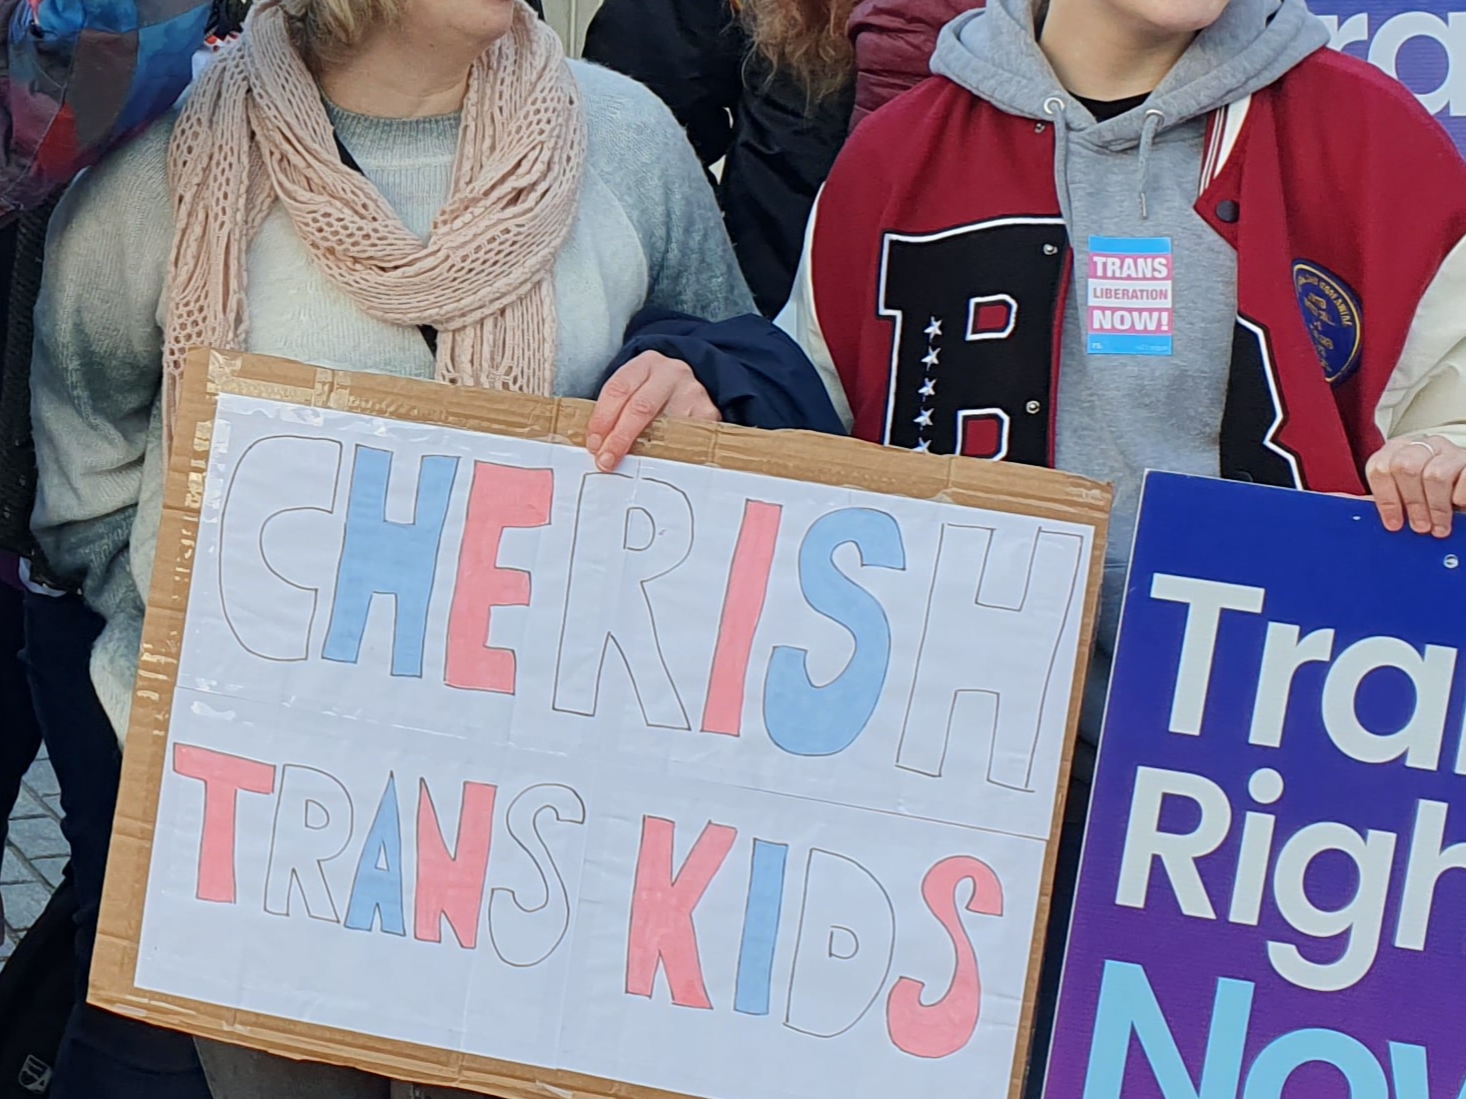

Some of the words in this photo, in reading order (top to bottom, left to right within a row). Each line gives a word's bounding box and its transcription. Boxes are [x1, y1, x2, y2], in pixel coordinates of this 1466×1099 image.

[1092, 256, 1168, 278] TRANS
[1092, 309, 1169, 331] NOW!
[1093, 287, 1168, 300] LIBERATION
[218, 434, 1083, 792] CHERISH
[1149, 572, 1466, 775] Tra
[173, 741, 585, 967] TRANS
[624, 814, 1005, 1058] KIDS
